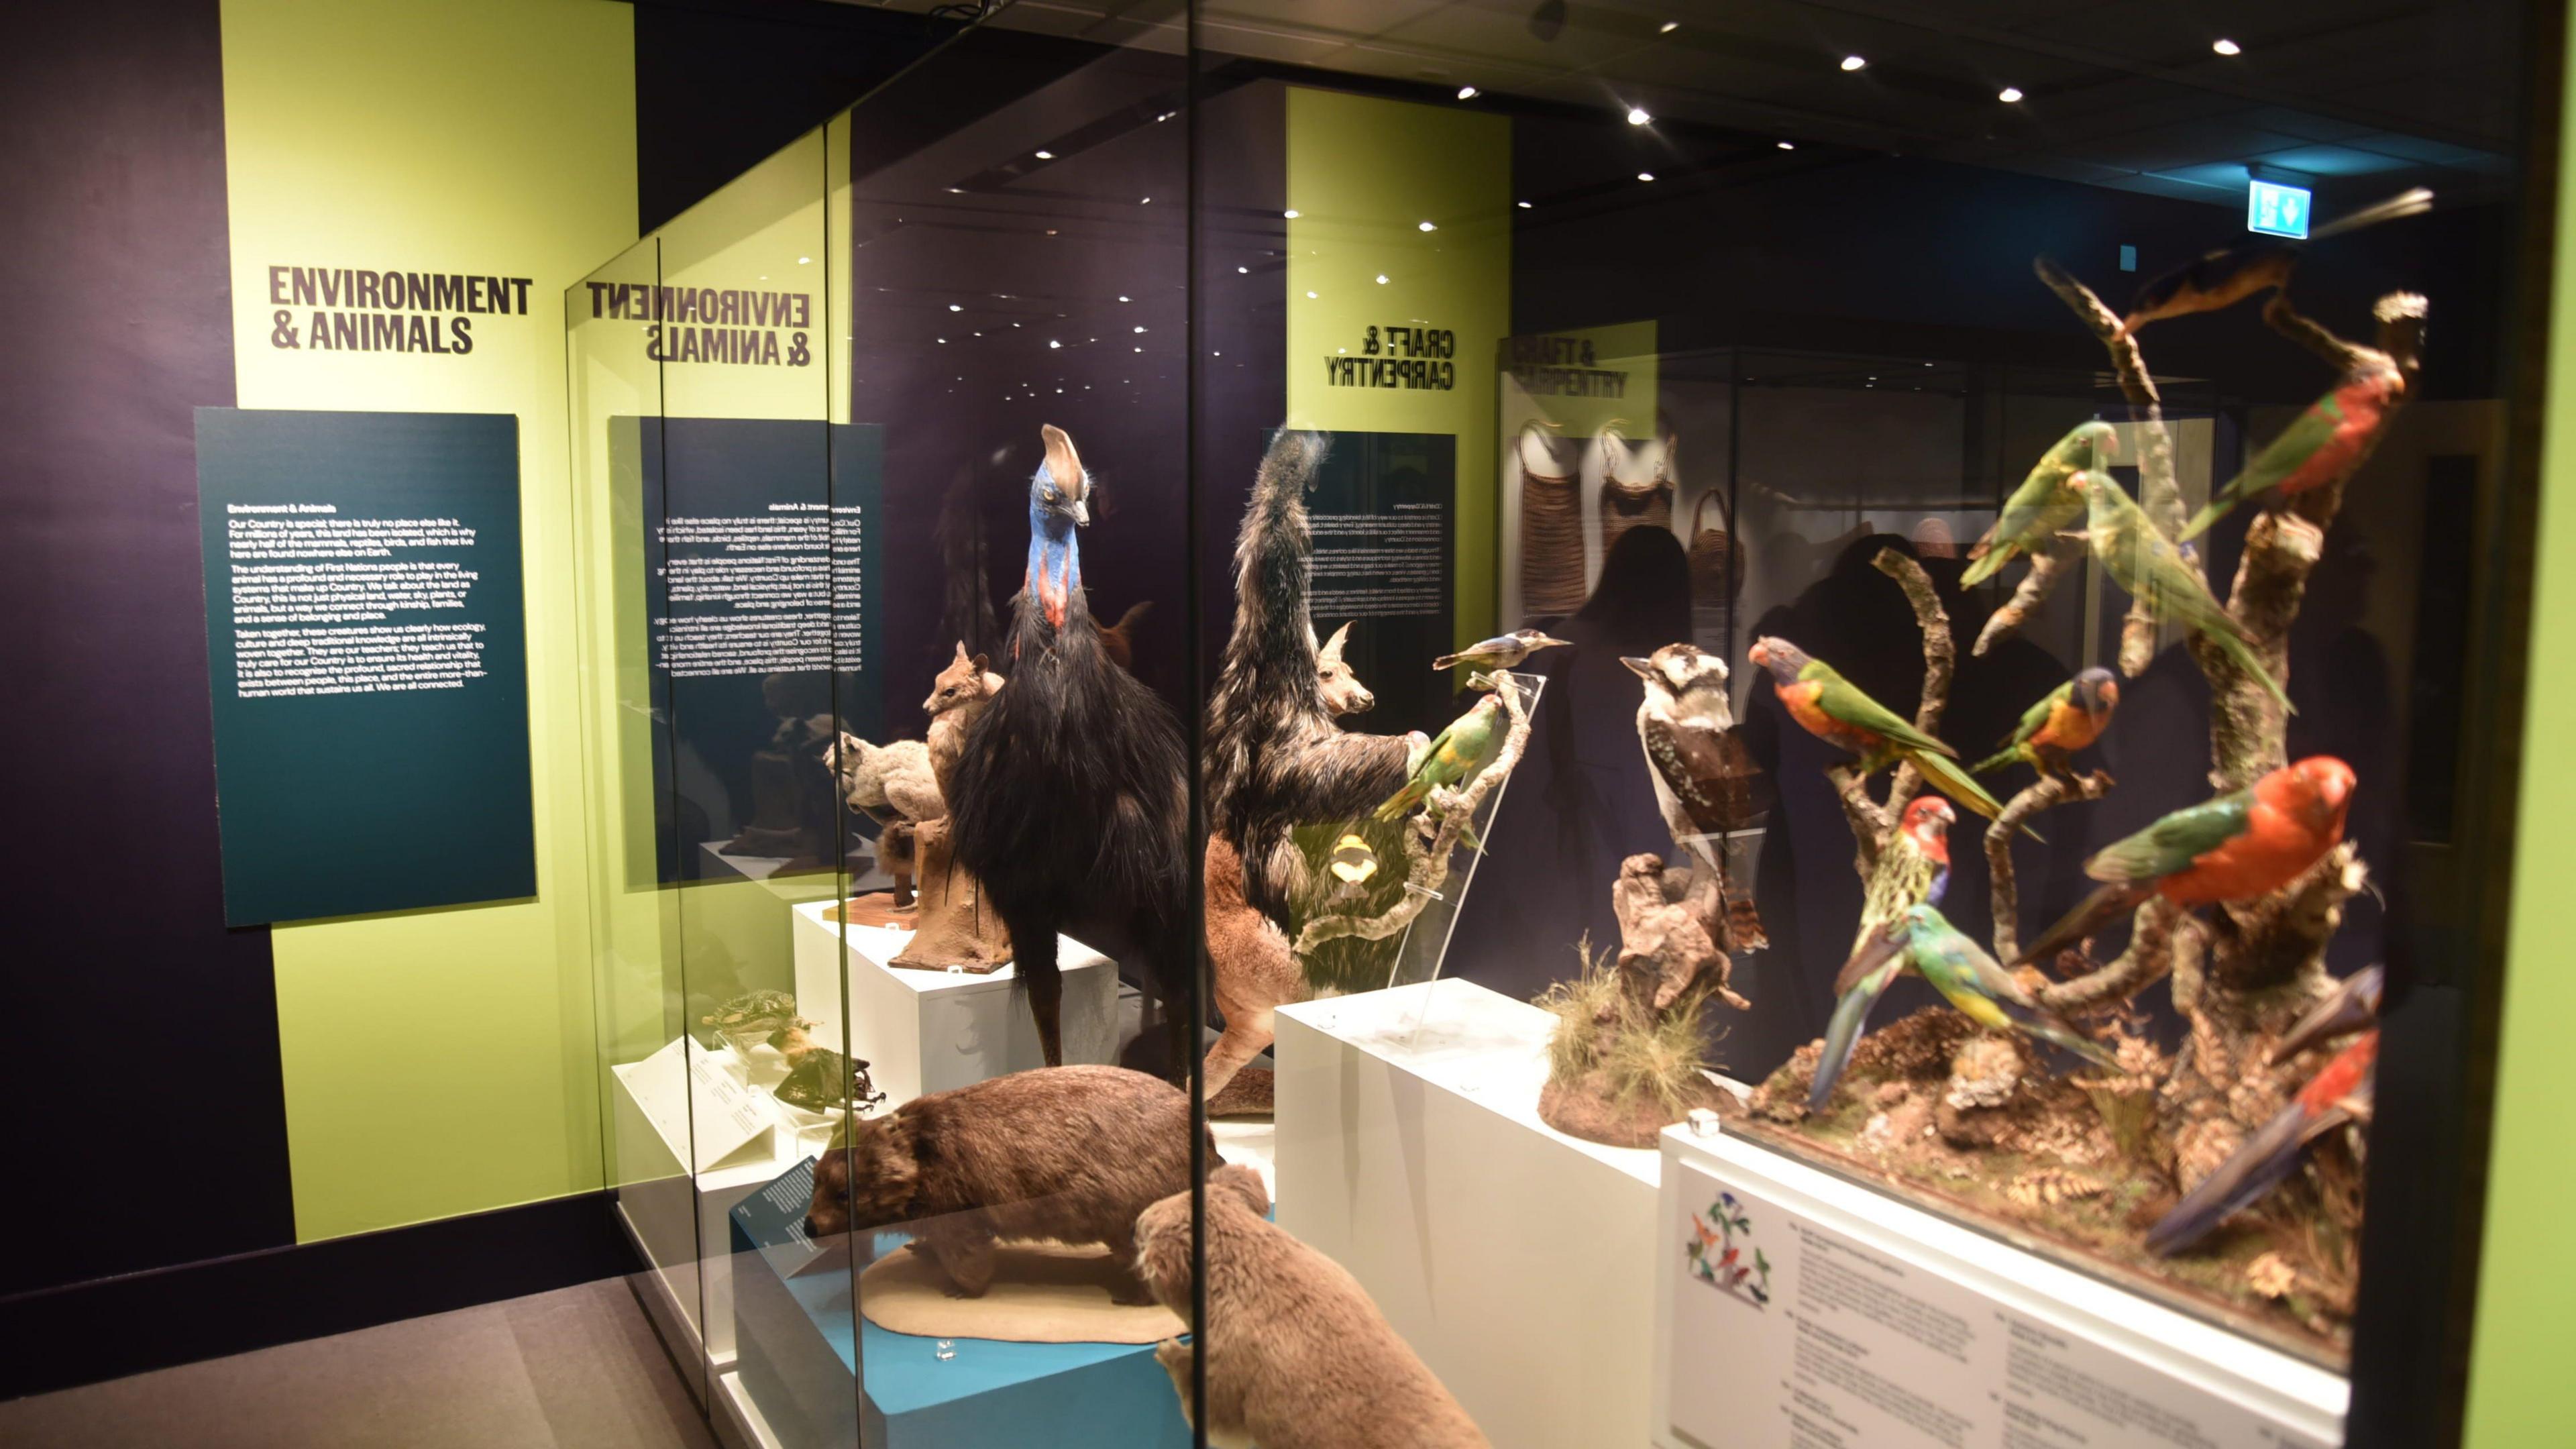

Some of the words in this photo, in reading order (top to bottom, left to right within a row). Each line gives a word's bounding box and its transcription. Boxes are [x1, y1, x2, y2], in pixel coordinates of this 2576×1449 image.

[269, 266, 533, 315] ENVIRONMENT
[271, 310, 301, 350] &
[309, 311, 472, 355] ANIMALS
[227, 504, 288, 513] Environment
[288, 504, 297, 513] &
[298, 504, 336, 513] Animals
[228, 520, 246, 528] Our
[248, 520, 284, 529] Country
[329, 519, 352, 527] there
[361, 519, 381, 528] truly
[394, 519, 419, 528] place
[437, 518, 451, 526] like
[229, 530, 243, 538] For
[244, 529, 278, 538] millions
[315, 529, 331, 537] this
[331, 529, 352, 537] land
[352, 529, 368, 537] has
[368, 528, 390, 537] been
[425, 527, 450, 536] which
[458, 527, 475, 537] why
[229, 540, 257, 549] nearly
[258, 539, 275, 547] half
[287, 539, 303, 547] the
[408, 537, 425, 545] and
[426, 537, 441, 545] fish
[442, 537, 459, 545] that
[460, 537, 474, 545] live
[229, 549, 251, 558] here
[268, 549, 295, 557] found
[295, 548, 334, 557] nowhere
[231, 565, 248, 573] The
[250, 564, 313, 574] understanding
[325, 563, 344, 572] First
[345, 562, 378, 571] Nations
[378, 562, 409, 572] people
[417, 561, 435, 570] that
[435, 562, 459, 571] every
[231, 575, 261, 584] animal
[262, 574, 278, 583] has
[285, 574, 326, 584] profound
[327, 573, 345, 582] and
[343, 574, 388, 582] necessary
[388, 572, 405, 580] role
[415, 571, 433, 581] play
[443, 571, 457, 579] the
[458, 570, 478, 580] living
[232, 584, 270, 594] systems
[270, 584, 288, 592] that
[290, 584, 315, 592] make
[400, 581, 424, 589] about
[425, 580, 440, 588] the
[441, 580, 459, 588] land
[271, 594, 288, 602] this
[297, 594, 312, 602] not
[313, 593, 329, 602] just
[330, 592, 366, 602] physical
[270, 604, 286, 612] but
[294, 604, 313, 613] way
[328, 602, 364, 610] connect
[365, 600, 399, 611] through
[233, 614, 252, 623] and
[298, 612, 341, 623] belonging
[342, 611, 360, 620] and
[235, 629, 261, 638] Taken
[302, 627, 327, 636] these
[327, 626, 368, 635] creatures
[369, 625, 392, 634] show
[405, 624, 432, 634] clearly
[433, 623, 451, 631] how
[235, 639, 267, 648] culture
[268, 639, 286, 647] and
[286, 637, 310, 648] deep
[311, 636, 354, 645] traditional
[355, 635, 400, 645] knowledge
[427, 632, 471, 643] intrinsically
[236, 650, 266, 658] woven
[307, 647, 327, 657] They
[400, 643, 419, 653] they
[421, 642, 445, 651] teach
[457, 641, 474, 649] that
[236, 659, 257, 669] truly
[279, 657, 292, 666] for
[310, 655, 345, 666] Country
[407, 652, 433, 661] health
[434, 651, 451, 659] and
[254, 668, 272, 677] also
[284, 666, 327, 677] recognise
[327, 665, 343, 674] the
[386, 662, 415, 672] sacred
[416, 660, 463, 672] relationship
[464, 659, 480, 668] that
[264, 677, 304, 686] between
[337, 674, 354, 683] this
[381, 672, 398, 681] and
[398, 672, 413, 680] the
[238, 688, 270, 697] human
[270, 687, 296, 696] world
[297, 686, 314, 694] that
[315, 684, 351, 694] sustains
